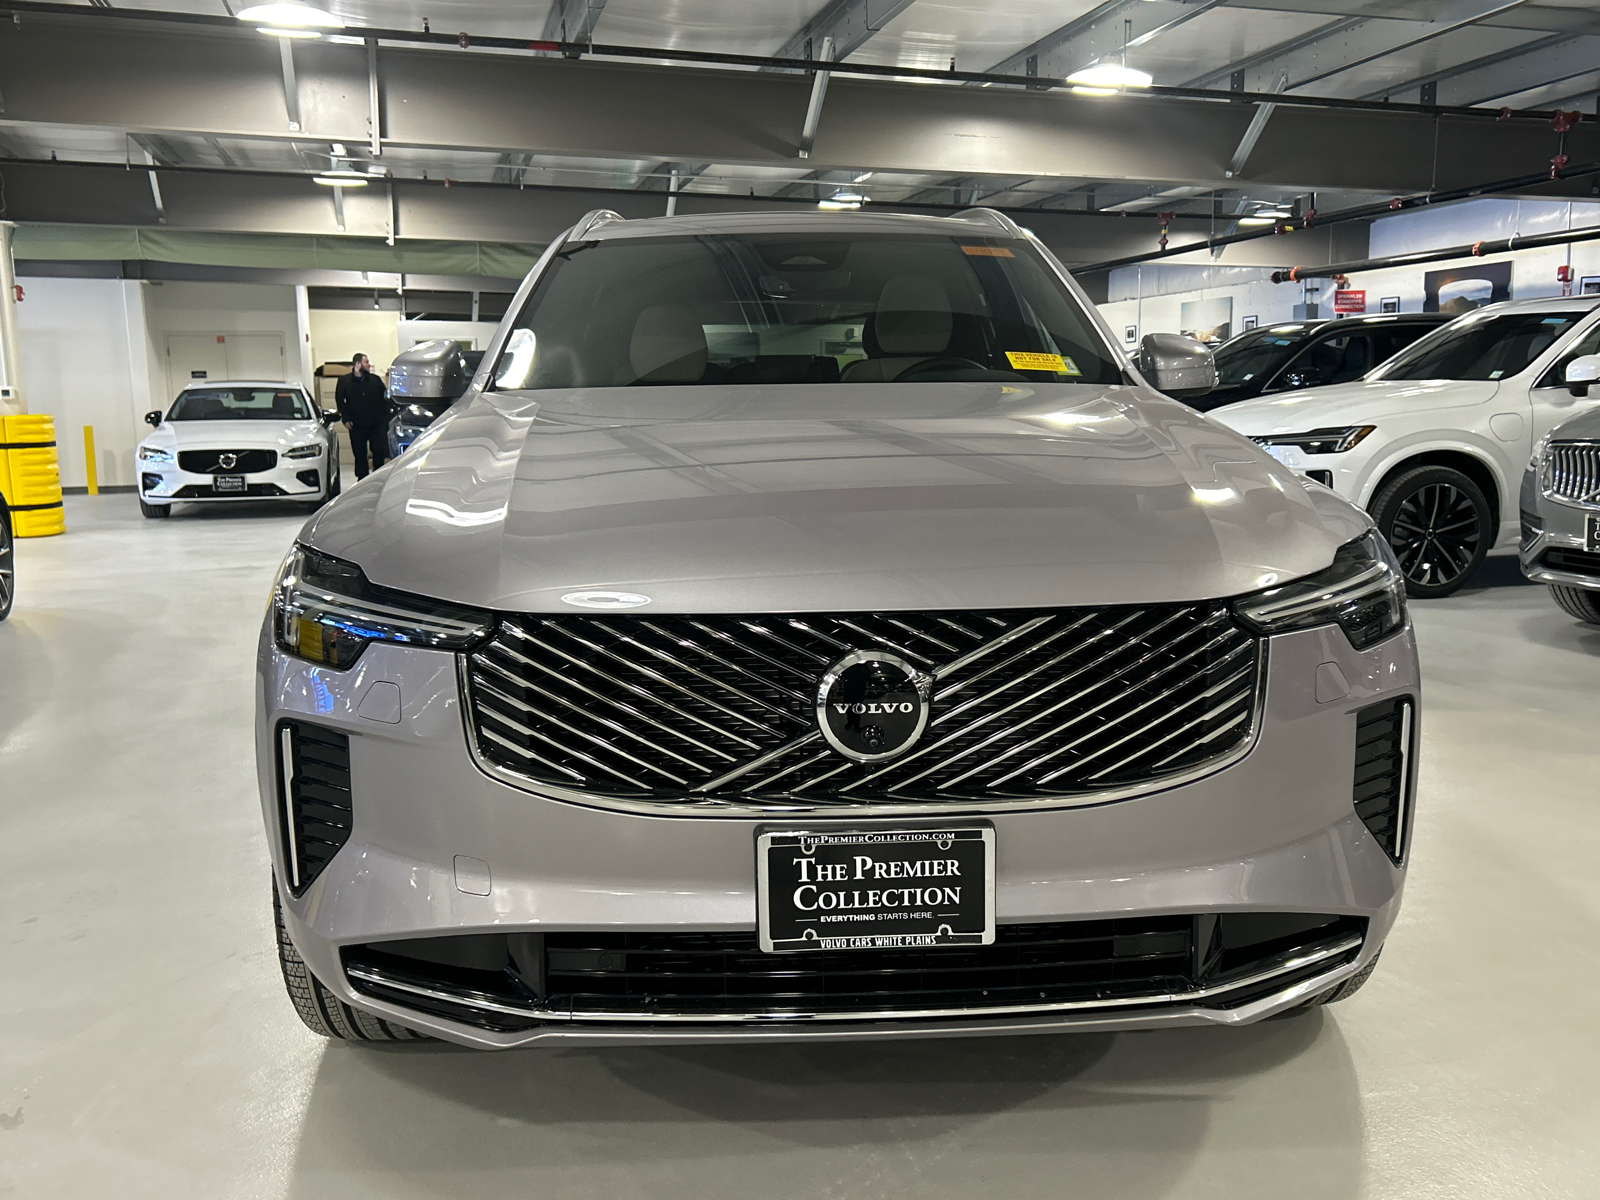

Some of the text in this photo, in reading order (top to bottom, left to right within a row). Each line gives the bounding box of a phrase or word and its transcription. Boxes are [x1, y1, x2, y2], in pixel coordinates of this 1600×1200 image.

[833, 702, 914, 714] VOLVO
[798, 833, 955, 844] THEPREMIERCOLLECTION.COM
[793, 856, 961, 882] THE PREMIER
[793, 885, 961, 910] COLLECTION
[820, 911, 935, 923] EVERYTHING STARTS HERE.
[820, 935, 937, 949] VOLVO CARS WHITE PLAINS
